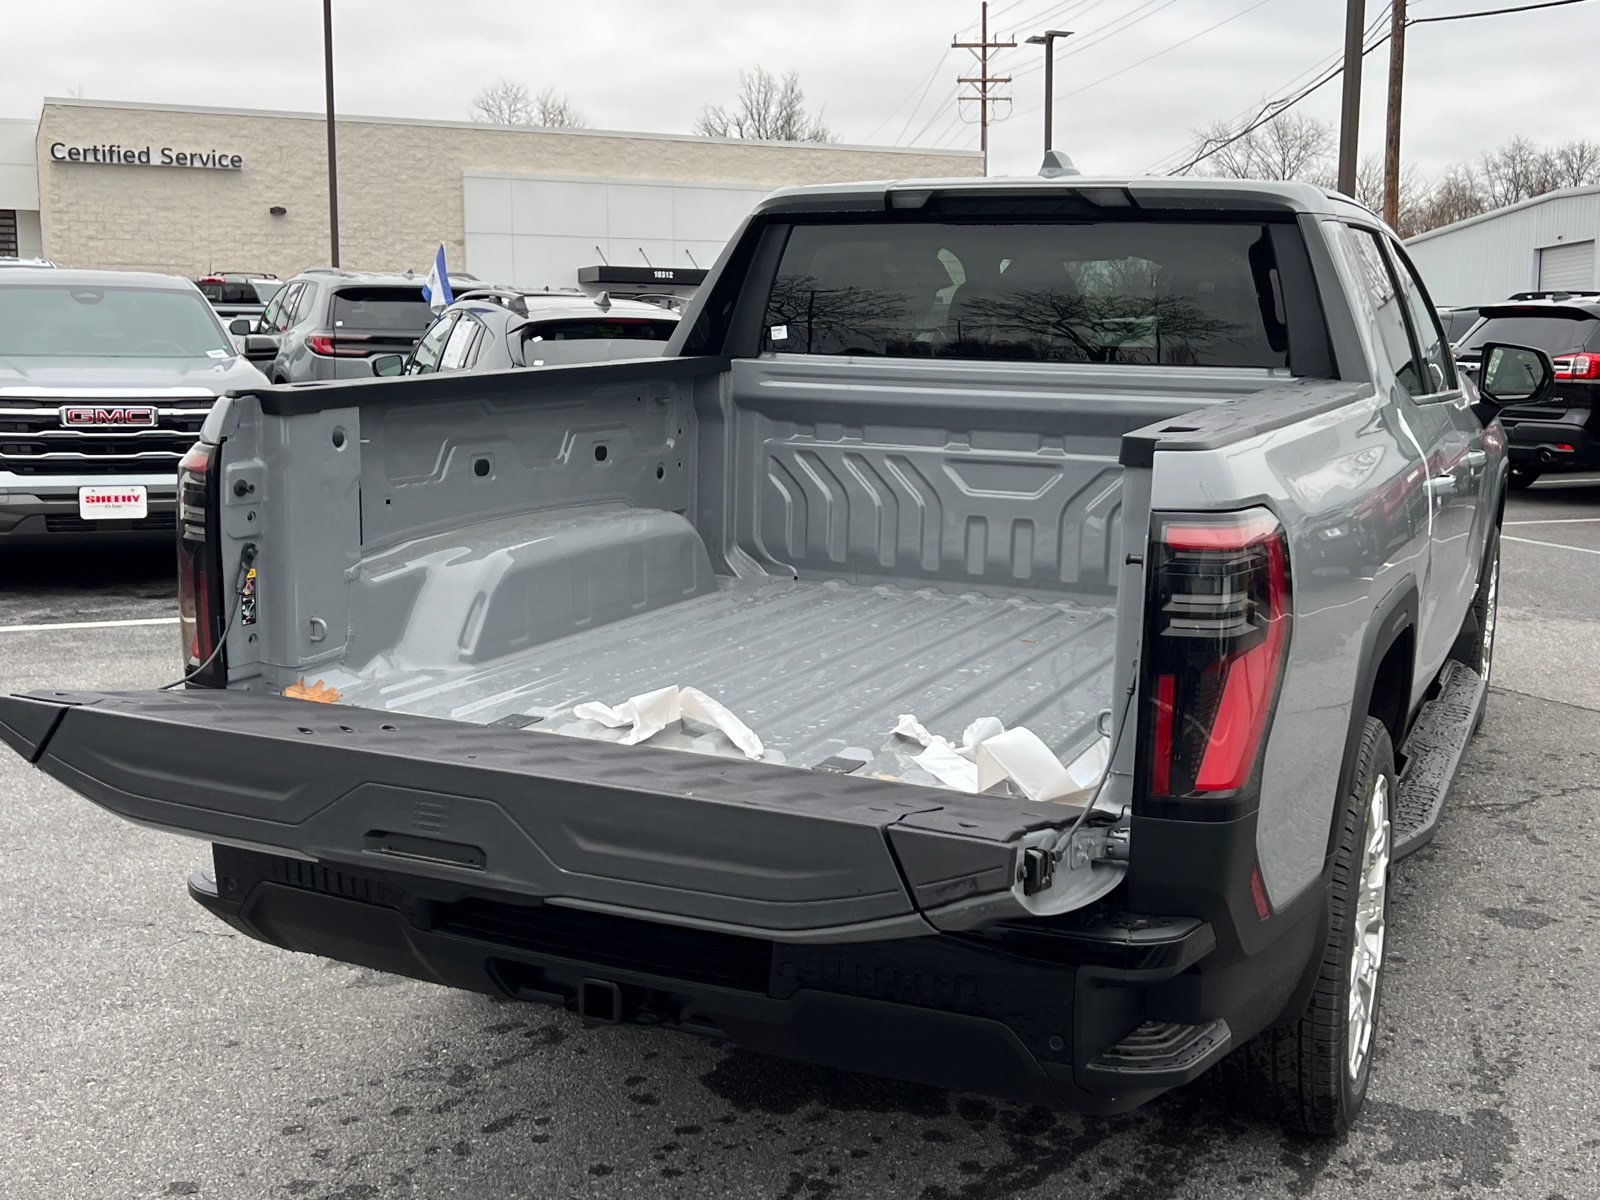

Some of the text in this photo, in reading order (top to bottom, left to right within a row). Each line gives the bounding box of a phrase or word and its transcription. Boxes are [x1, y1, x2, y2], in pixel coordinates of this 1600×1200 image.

[50, 142, 243, 168] Certified Service
[653, 270, 674, 279] 10312
[67, 408, 151, 424] GMC
[85, 494, 141, 503] SHEEHY
